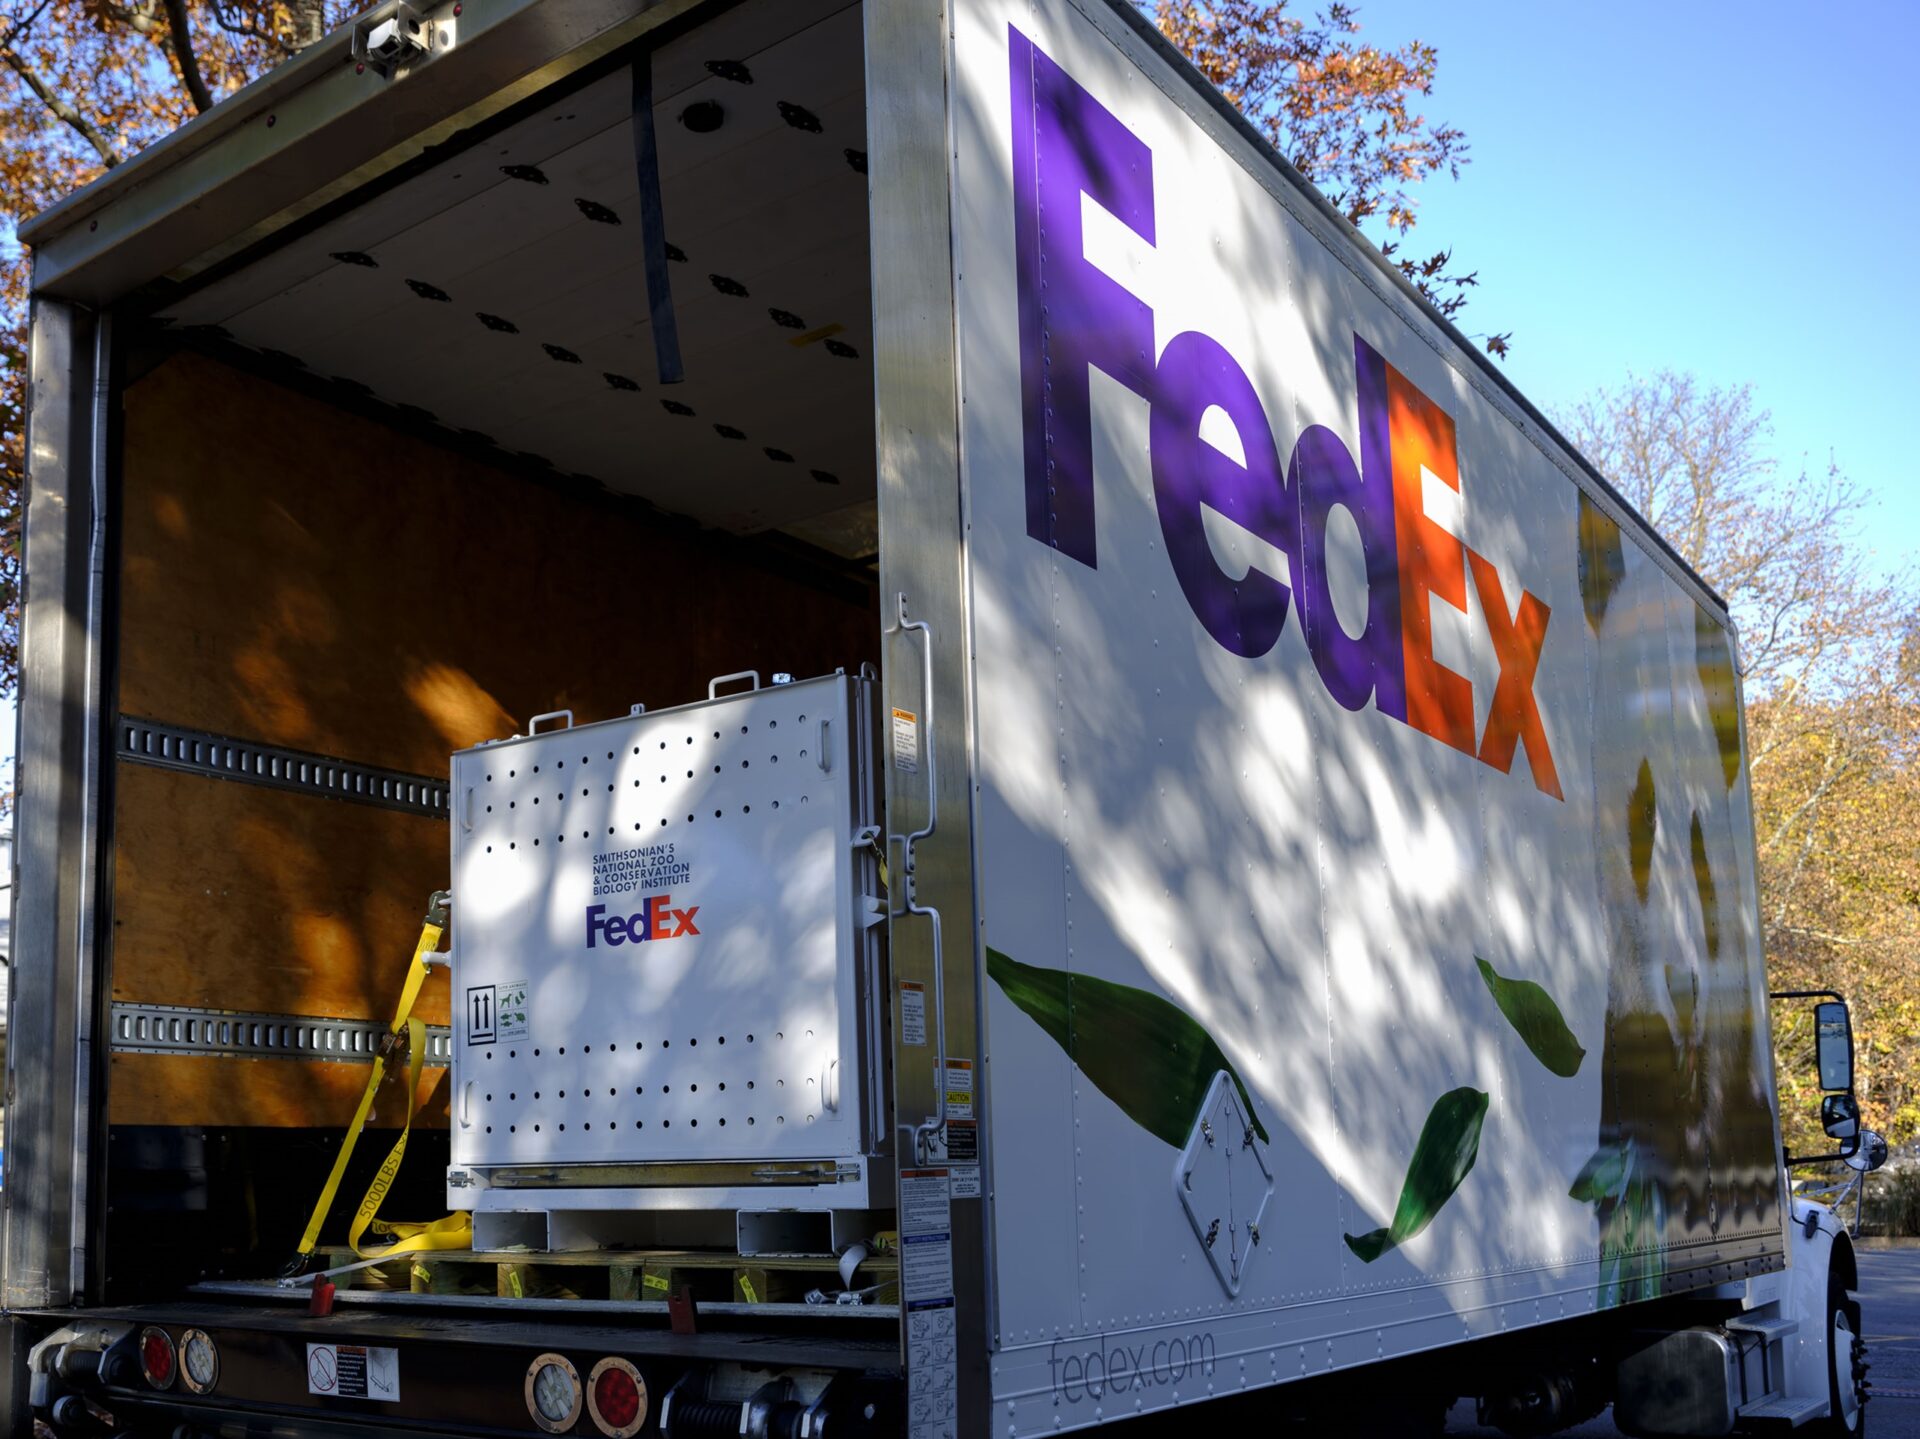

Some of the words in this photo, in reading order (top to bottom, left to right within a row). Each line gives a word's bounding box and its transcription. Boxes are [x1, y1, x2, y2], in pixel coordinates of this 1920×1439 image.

[1008, 21, 1564, 801] FedEx
[593, 843, 675, 865] SMITHSONIAN'S
[593, 858, 647, 875] NATIONAL
[650, 854, 675, 867] ZOO
[593, 876, 600, 886] &
[604, 862, 690, 884] CONSERVATION
[593, 881, 638, 896] BIOLOGY
[641, 873, 690, 890] INSTITUTE
[586, 895, 701, 949] FedEx
[359, 1157, 399, 1220] 5000LBS
[1047, 1332, 1216, 1405] fedex.com
